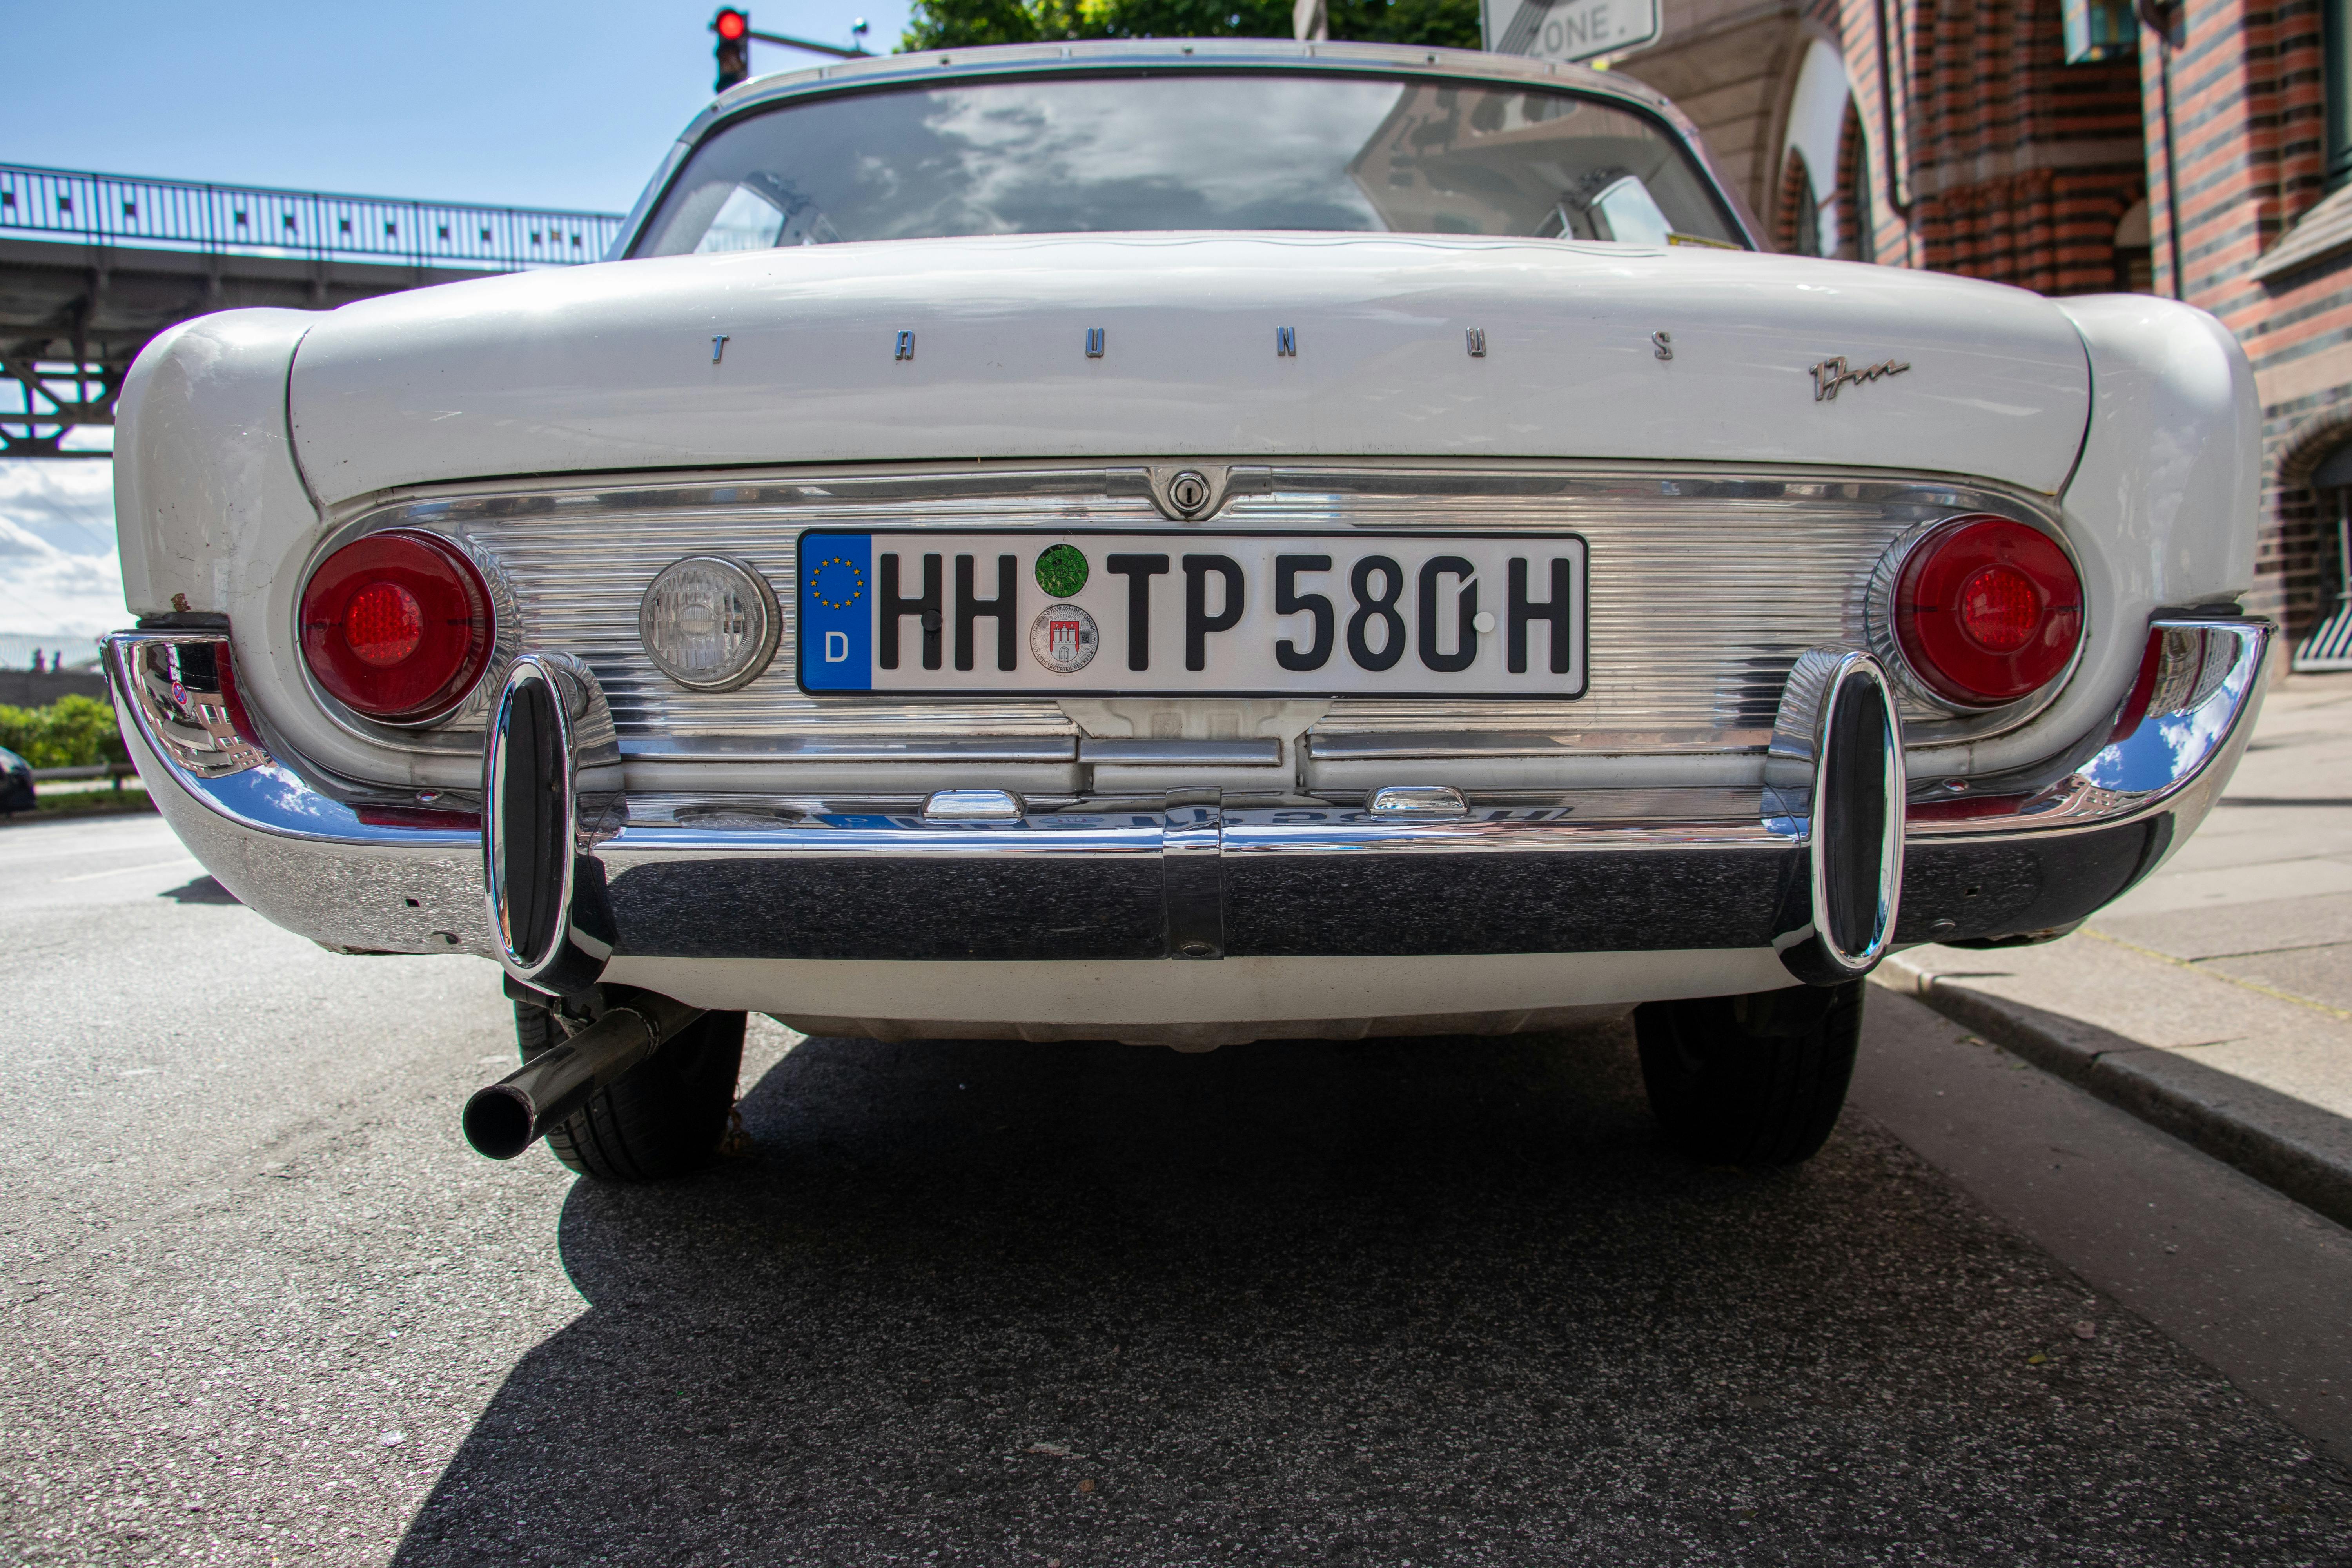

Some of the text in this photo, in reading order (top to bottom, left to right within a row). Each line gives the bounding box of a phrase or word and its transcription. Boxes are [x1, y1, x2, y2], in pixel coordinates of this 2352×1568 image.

[826, 631, 848, 662] D
[879, 553, 1018, 671] HH
[1107, 554, 1245, 671] TP
